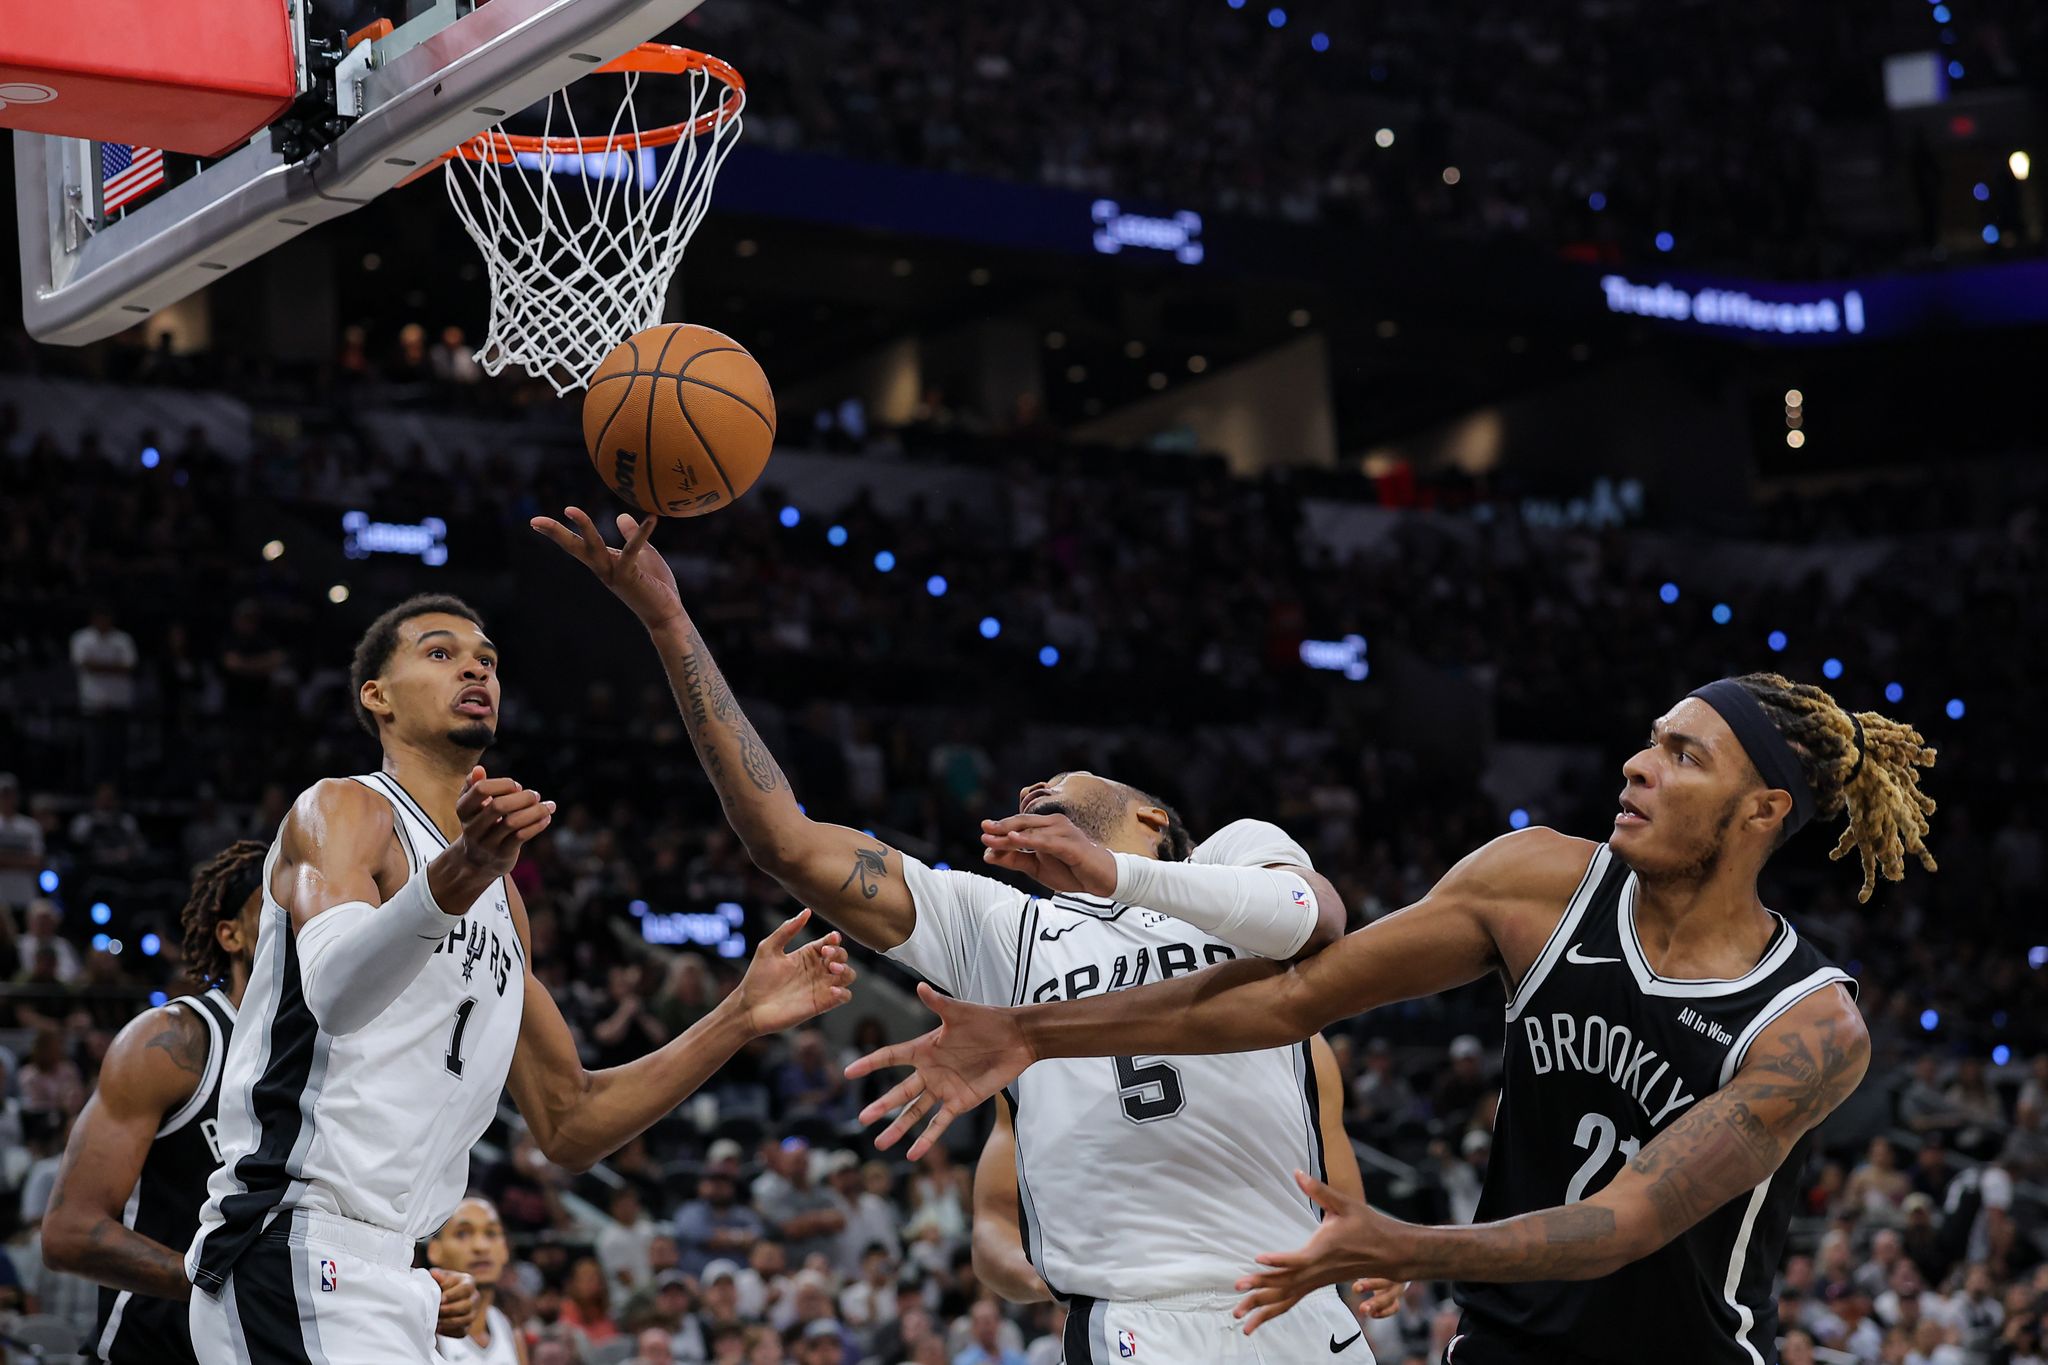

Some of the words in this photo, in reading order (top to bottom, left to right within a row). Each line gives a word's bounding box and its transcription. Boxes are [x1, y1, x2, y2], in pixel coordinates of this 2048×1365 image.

[434, 917, 512, 998] PURS
[444, 995, 478, 1081] 1
[1677, 1006, 1697, 1027] All
[1693, 1014, 1707, 1034] In
[1707, 1020, 1733, 1046] Won
[1111, 1055, 1187, 1125] 5
[1524, 1012, 1695, 1127] BROOKLY
